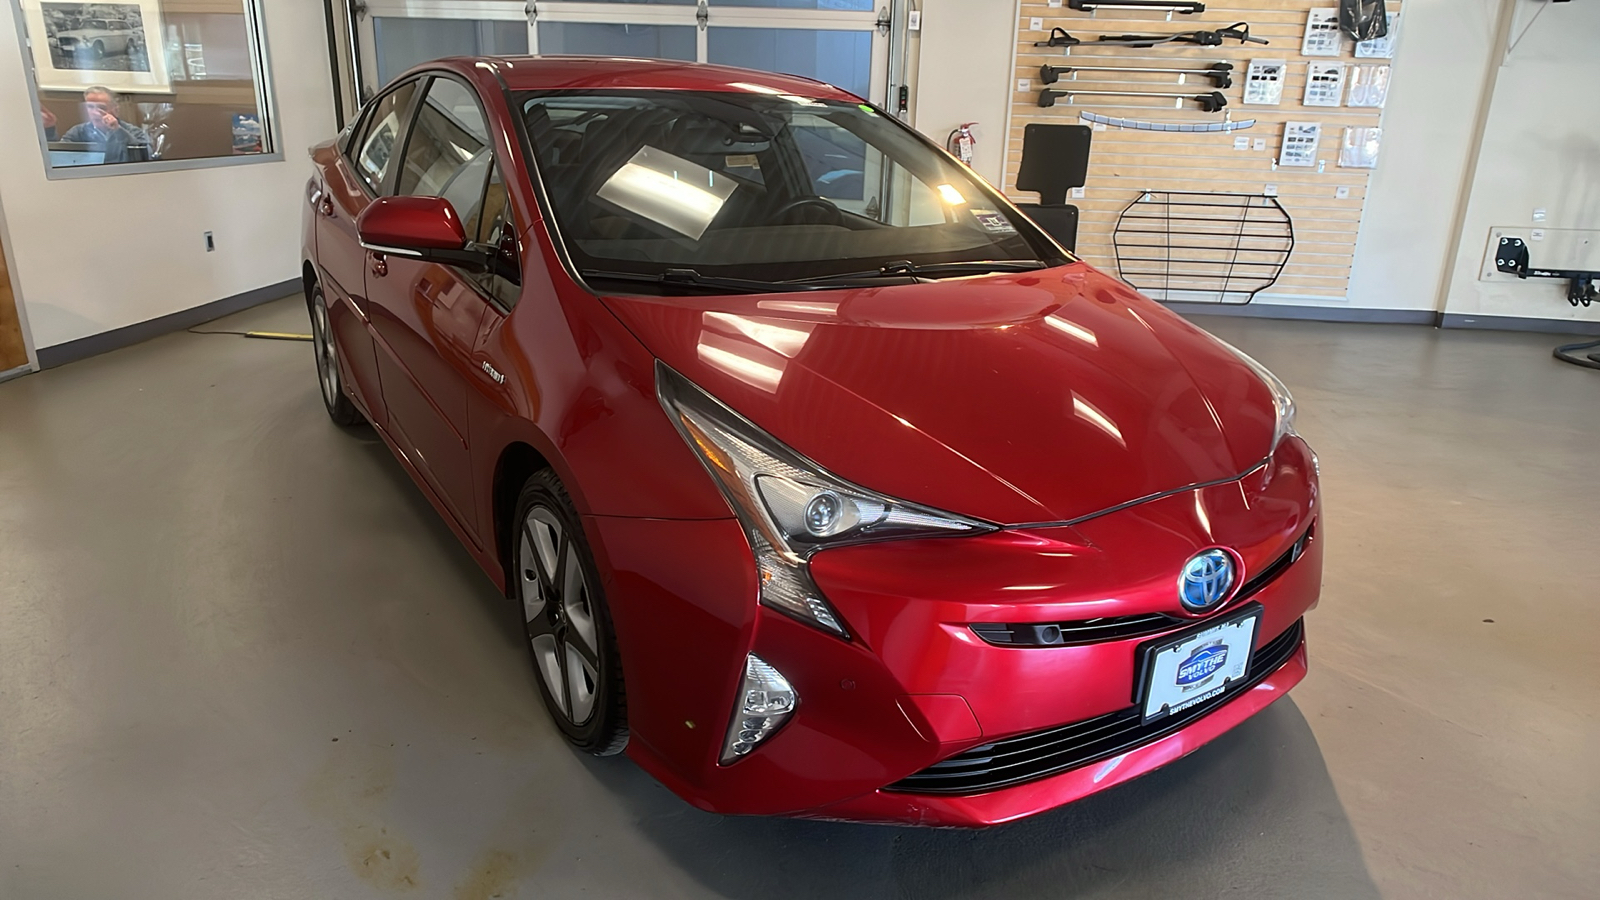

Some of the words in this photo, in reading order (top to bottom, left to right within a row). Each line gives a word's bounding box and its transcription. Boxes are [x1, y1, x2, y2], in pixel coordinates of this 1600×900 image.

[1178, 654, 1225, 679] SMYTHE
[1188, 665, 1215, 680] VOLVO
[1169, 686, 1226, 716] SMYTHEVOLVO.COM
